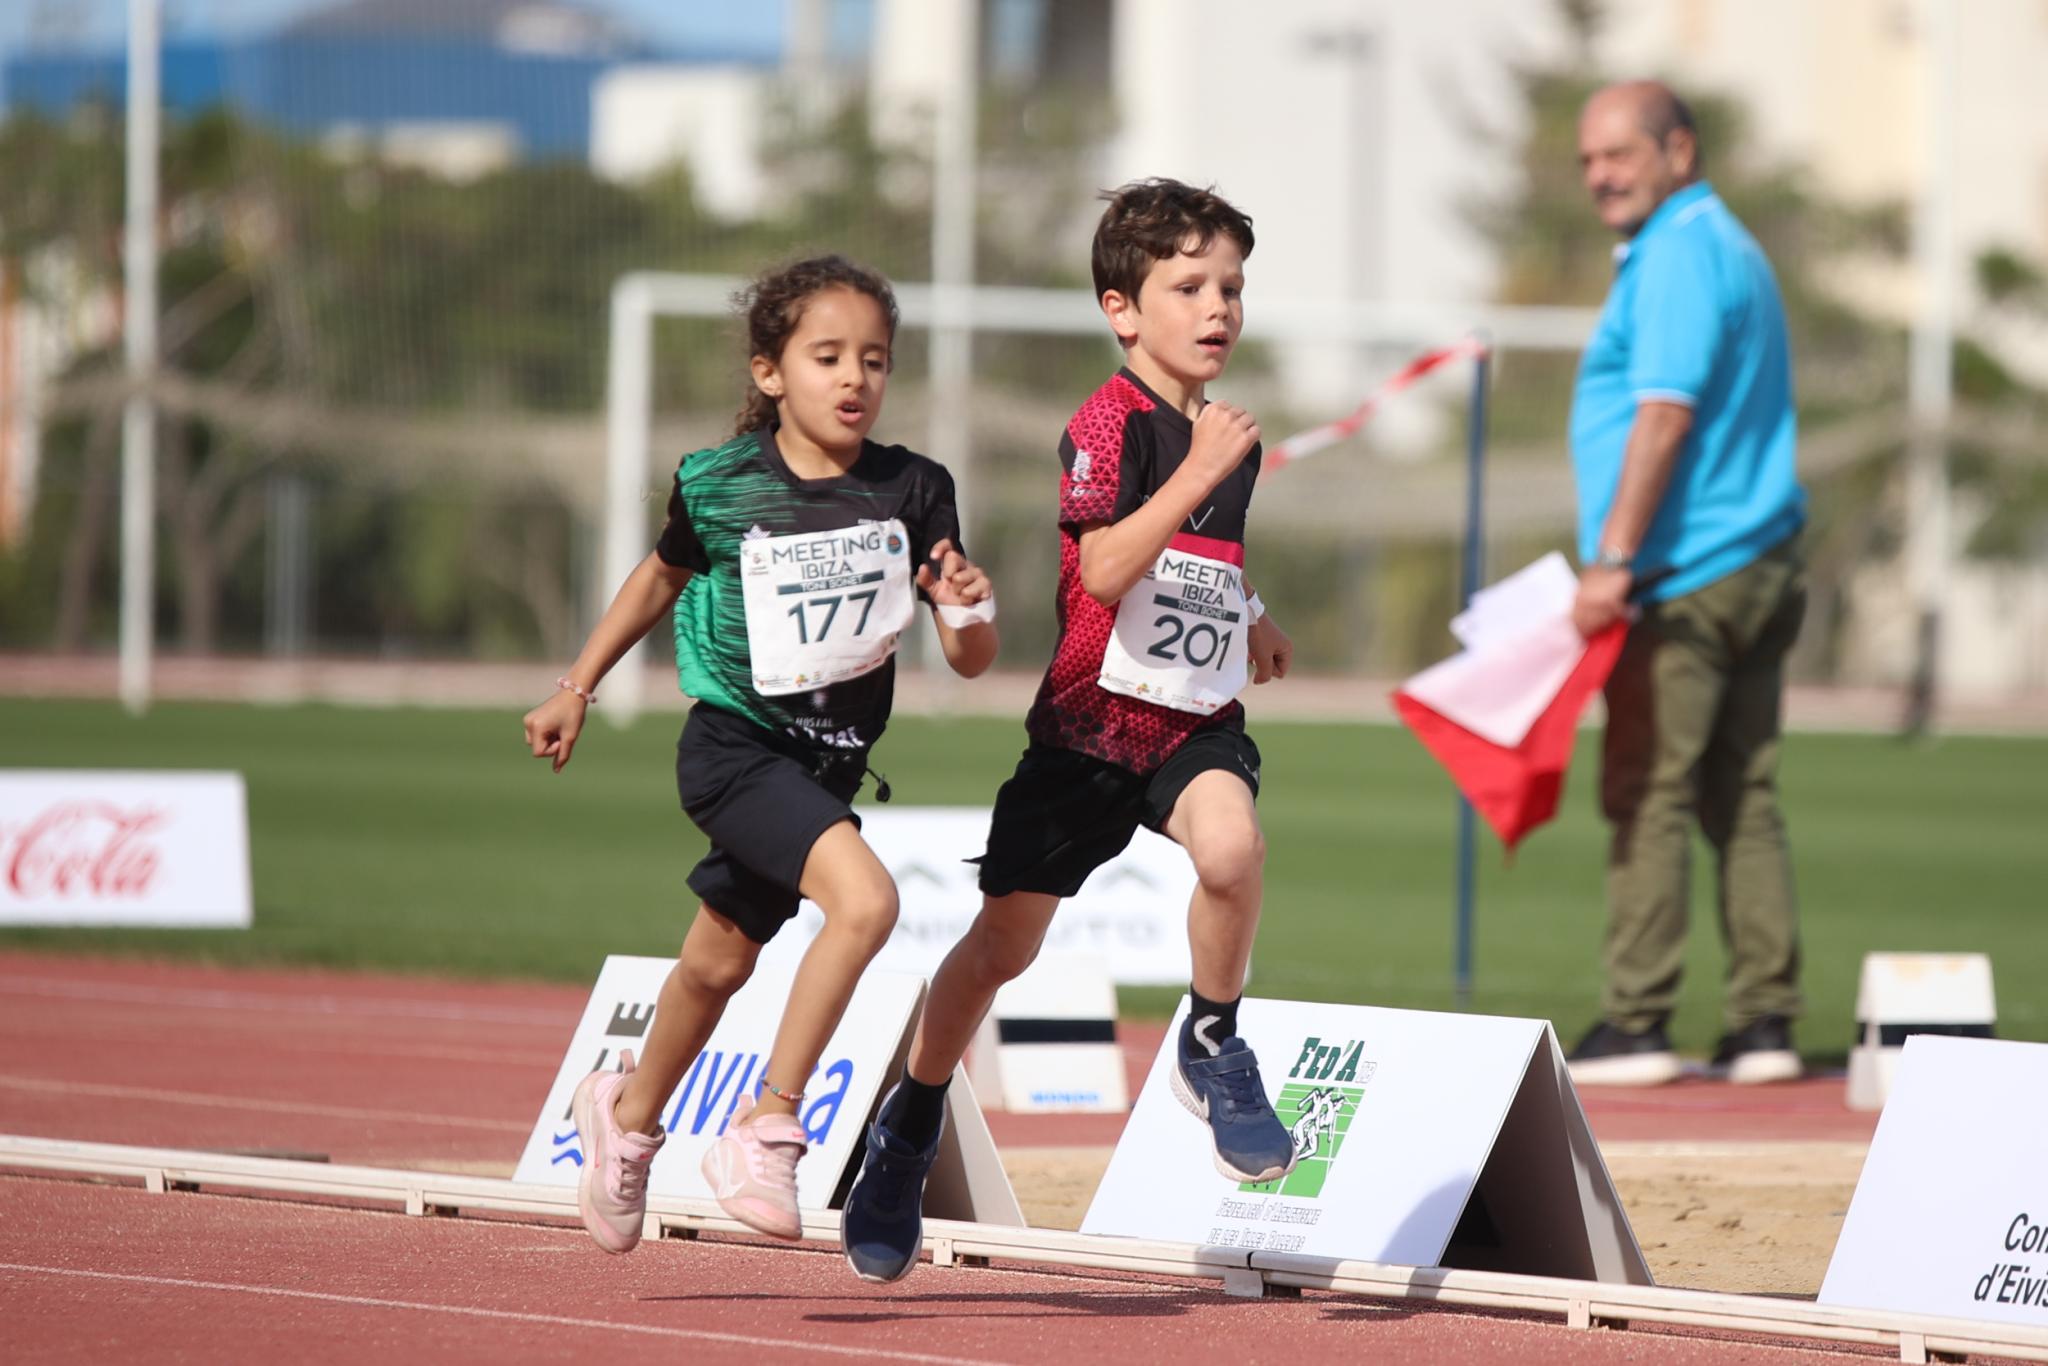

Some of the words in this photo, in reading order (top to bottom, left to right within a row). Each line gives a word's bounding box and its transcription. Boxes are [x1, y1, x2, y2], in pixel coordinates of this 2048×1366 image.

[771, 531, 881, 564] MEETING
[801, 560, 853, 580] IBIZA
[801, 580, 827, 593] TONI
[1182, 583, 1224, 607] IBIZA
[788, 588, 878, 644] 177
[1177, 600, 1200, 613] TONI
[1200, 605, 1228, 619] BONET
[1147, 614, 1232, 671] 201
